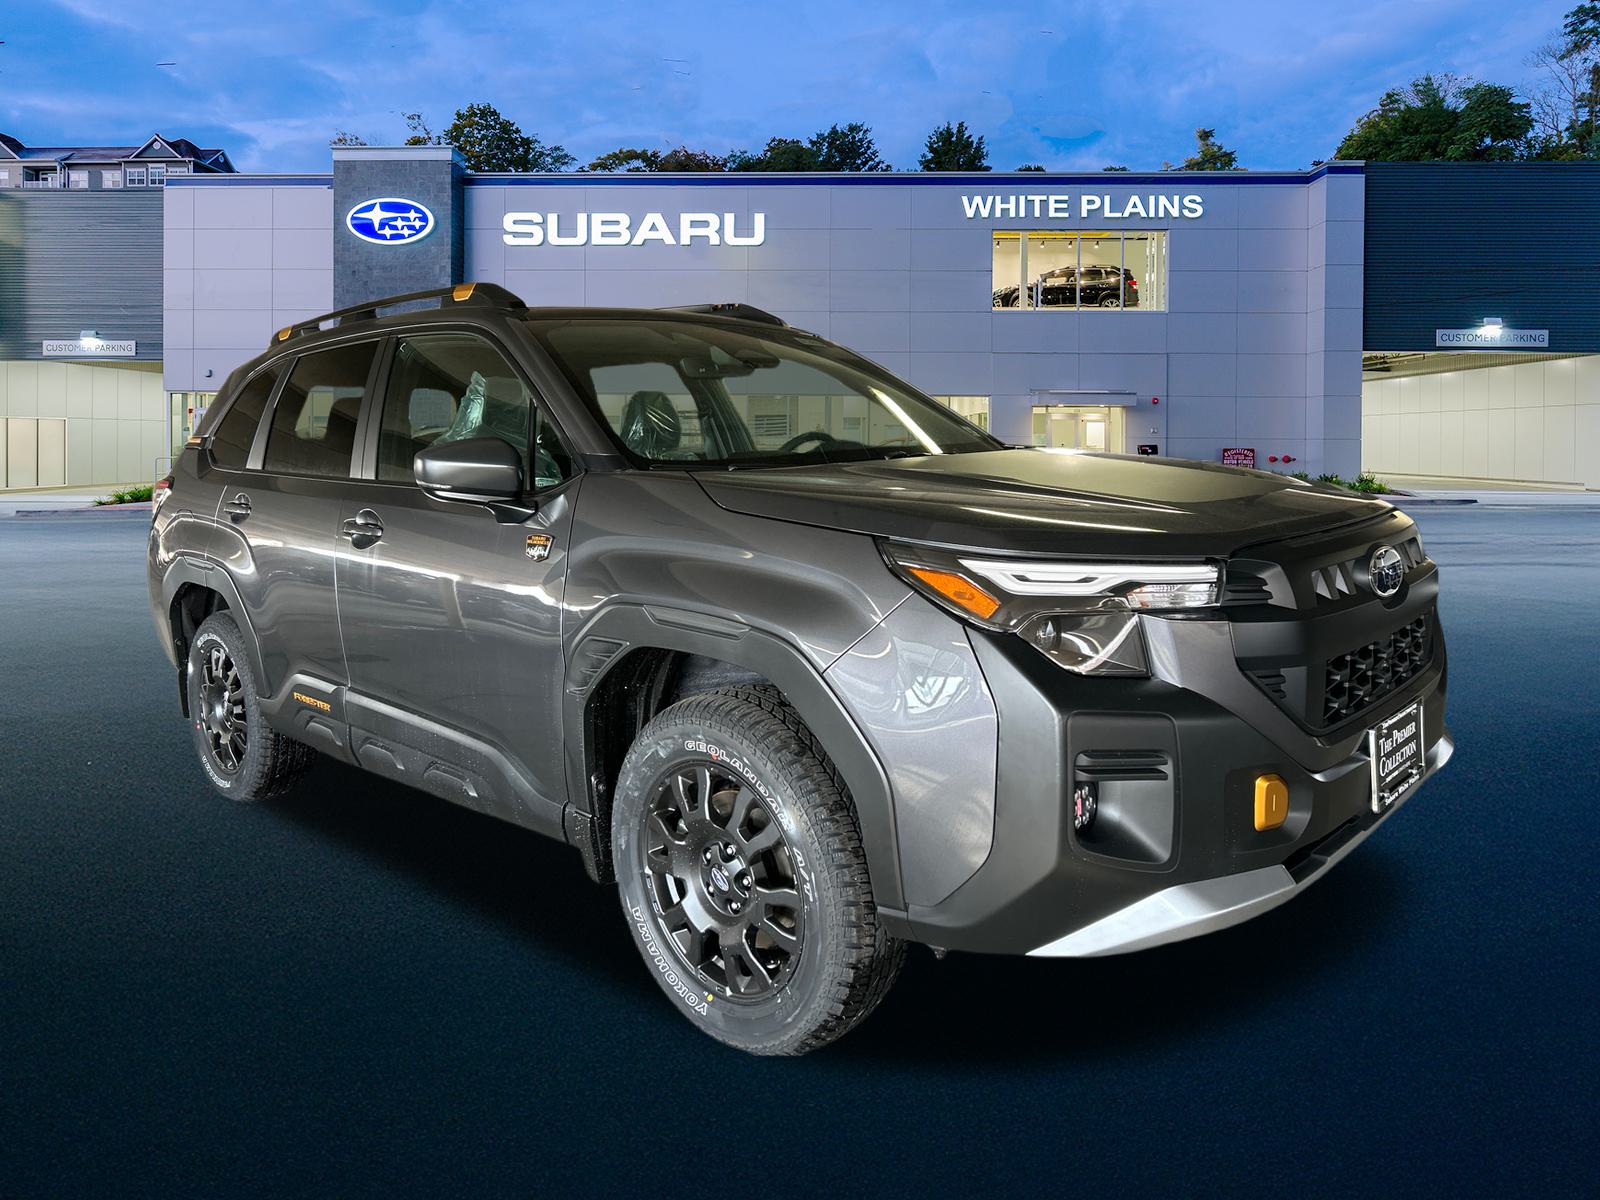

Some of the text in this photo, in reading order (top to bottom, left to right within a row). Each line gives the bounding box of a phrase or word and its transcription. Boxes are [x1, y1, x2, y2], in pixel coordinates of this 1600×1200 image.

[961, 195, 1204, 219] WHITE PLAINS
[502, 212, 765, 246] SUBARU
[94, 343, 133, 352] PARKING
[1440, 333, 1546, 343] CUSTOMER PARKING
[1379, 721, 1417, 757] THE PREMIER
[1379, 740, 1417, 777] COLLECTION
[793, 847, 814, 902] A/T
[631, 906, 708, 1016] YOKOHAMA
